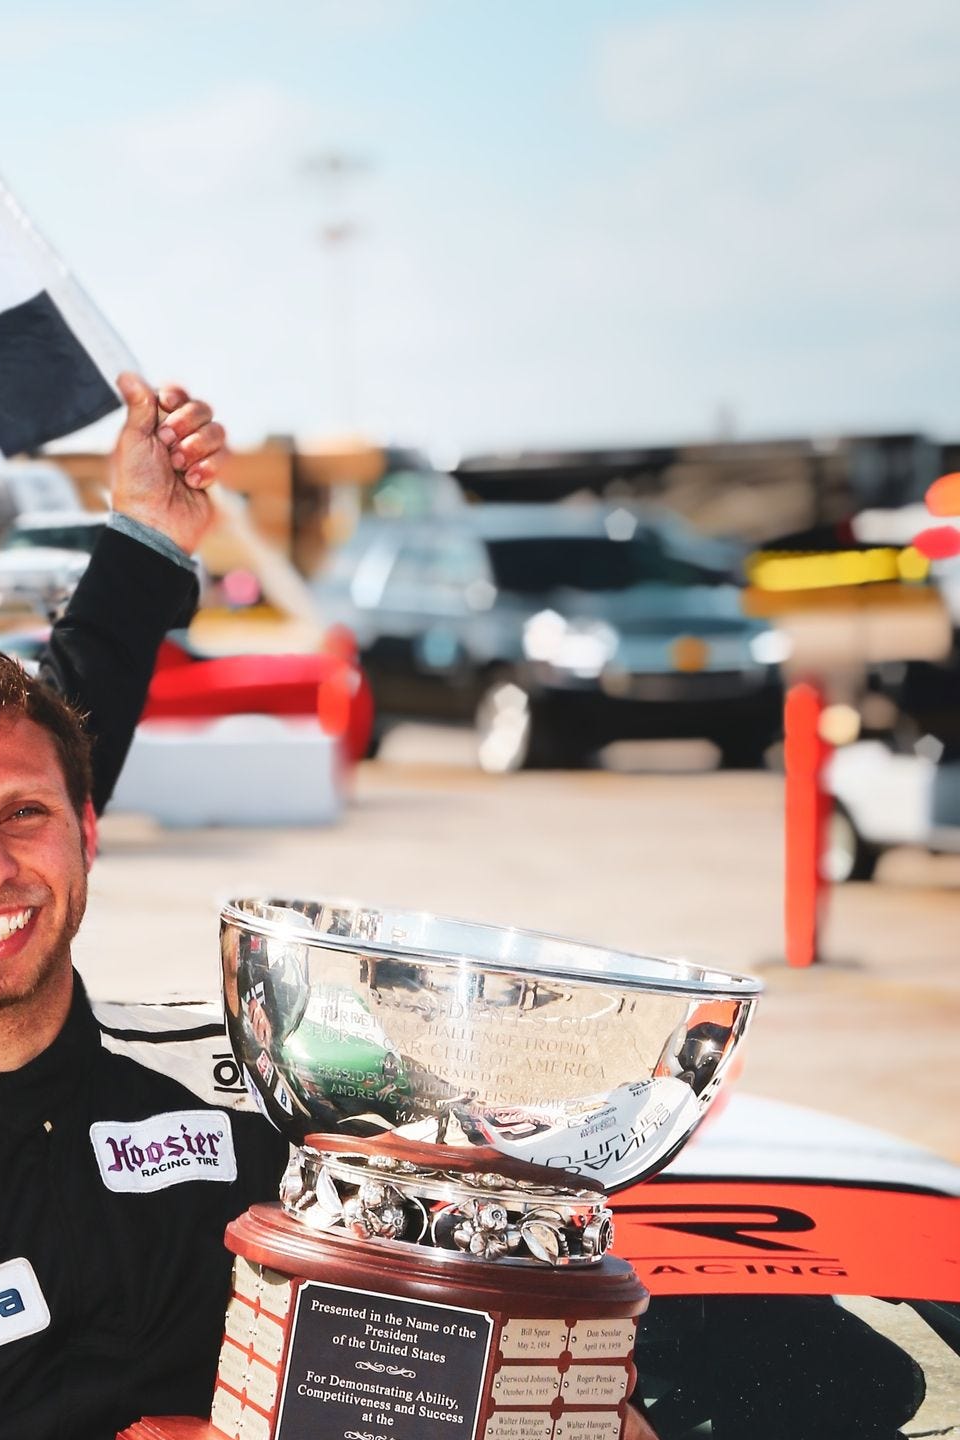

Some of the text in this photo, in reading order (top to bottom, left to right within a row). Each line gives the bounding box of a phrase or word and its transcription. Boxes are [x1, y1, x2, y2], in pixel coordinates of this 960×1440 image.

[525, 1057, 606, 1080] AMERICA
[141, 1157, 220, 1177] RACING TIRE
[311, 1300, 477, 1339] Presented in the Name of the
[364, 1324, 418, 1344] President
[333, 1335, 446, 1364] of the United States
[306, 1371, 459, 1410] For Demonstrating Ability,
[297, 1384, 464, 1424] Competitiveness and Success
[362, 1412, 394, 1426] at the
